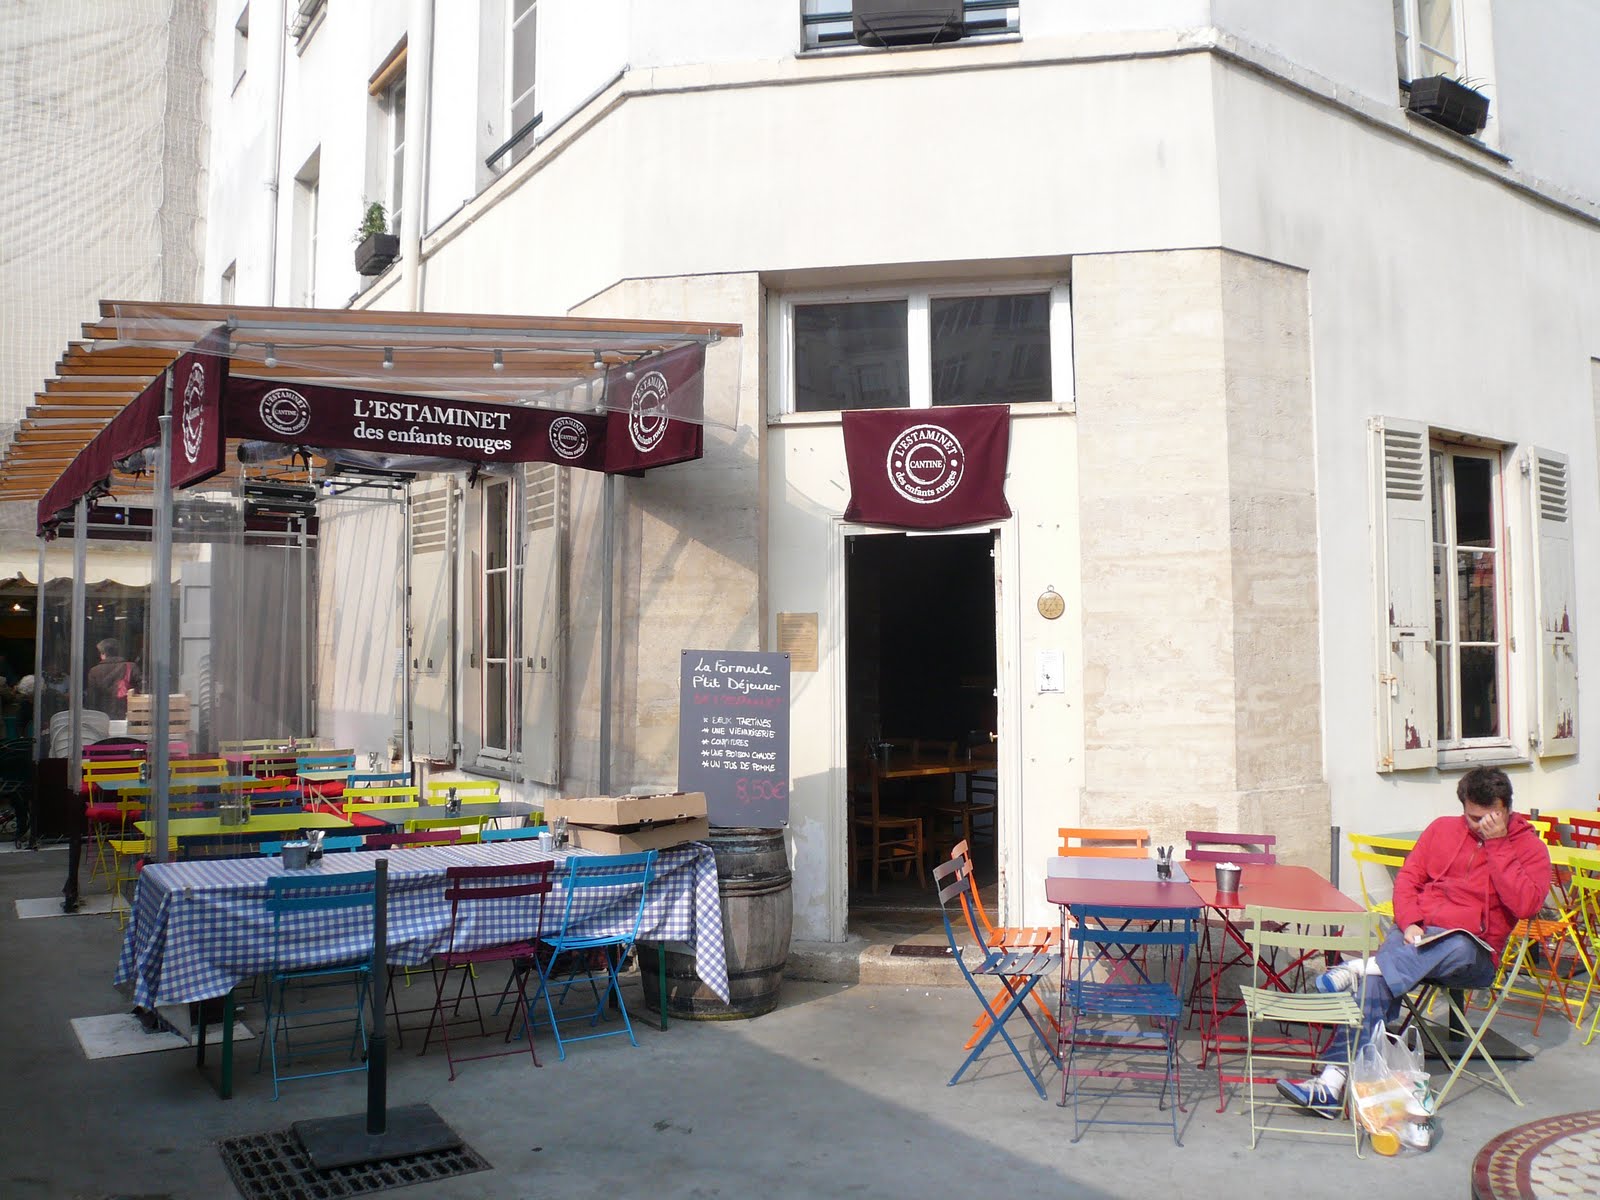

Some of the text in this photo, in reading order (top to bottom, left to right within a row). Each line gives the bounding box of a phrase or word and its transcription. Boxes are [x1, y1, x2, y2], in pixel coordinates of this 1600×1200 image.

[265, 391, 307, 409] L'ESTAMINET
[353, 398, 511, 431] L'ESTAMINET
[553, 419, 586, 435] L'ESTAMINET
[353, 421, 512, 455] des enfants rouges
[894, 429, 958, 457] L'ESTAMINET
[909, 460, 943, 469] CANTINE
[895, 470, 957, 497] des enfants rouges
[694, 657, 772, 675] La Formule
[692, 674, 781, 695] P'tit Déjeuner
[711, 727, 726, 735] UNE
[710, 748, 724, 757] UNE
[751, 751, 777, 760] CHAUDE
[709, 759, 776, 773] UN JUS DE POMME
